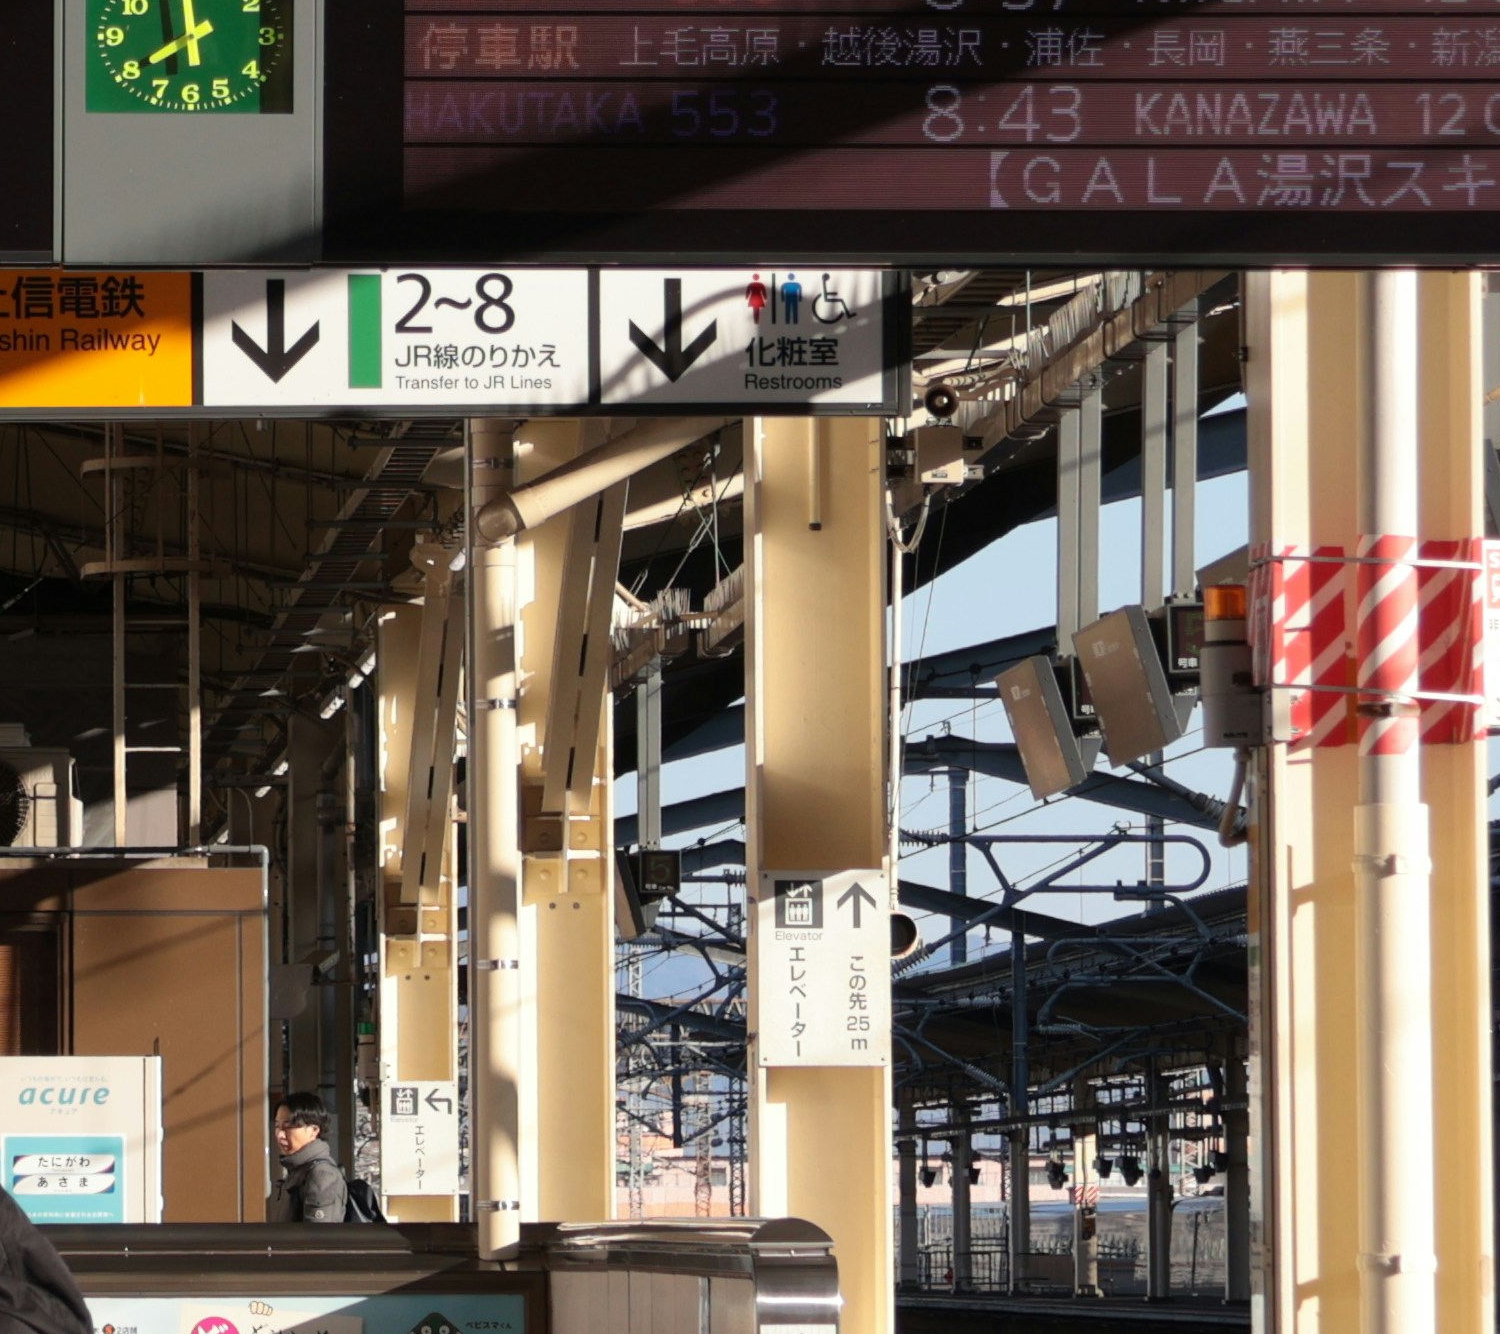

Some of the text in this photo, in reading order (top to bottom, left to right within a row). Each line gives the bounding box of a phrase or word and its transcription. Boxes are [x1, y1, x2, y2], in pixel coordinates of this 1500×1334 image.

[106, 27, 124, 46] 9
[258, 27, 275, 46] 3
[419, 23, 580, 70] 停車駅
[122, 60, 141, 79] 8
[242, 60, 260, 78] 4
[152, 79, 169, 98] 7
[181, 84, 200, 103] 6
[212, 78, 230, 98] 5
[404, 91, 648, 134] HAKUTAKA
[671, 91, 778, 137] 553
[922, 84, 1083, 142] 8:43
[1136, 93, 1377, 135] KANAZAWA
[1415, 93, 1466, 135] 12
[60, 327, 162, 360] Railway
[744, 336, 840, 367] 化粧室
[395, 342, 562, 370] JR線のりかえ
[395, 375, 552, 391] Transfer to JR Lines
[744, 373, 842, 390] Restrooms
[775, 930, 823, 941] Elevator
[789, 946, 807, 1057] エレベーター
[19, 1087, 110, 1105] acure
[37, 1156, 91, 1168] たにがわ
[414, 1125, 425, 1190] エレベーター
